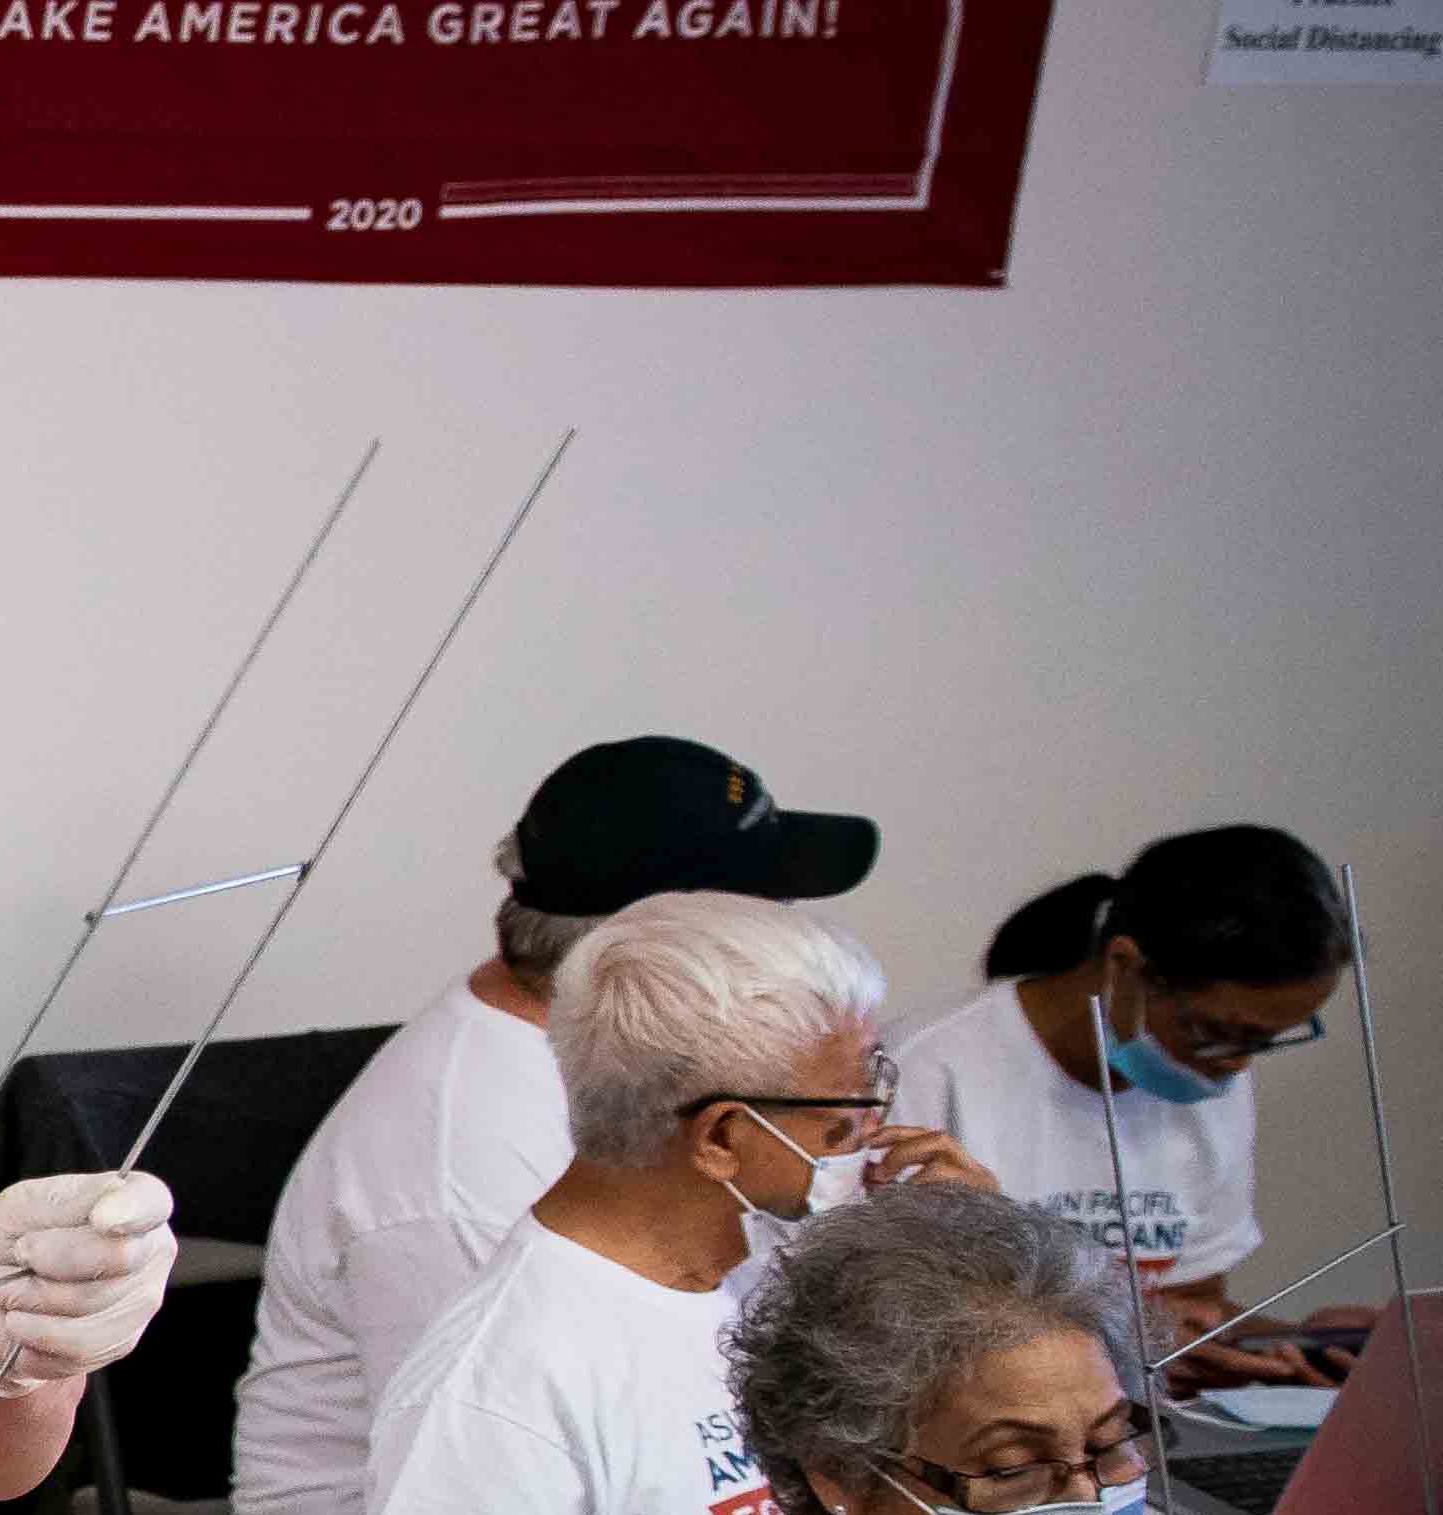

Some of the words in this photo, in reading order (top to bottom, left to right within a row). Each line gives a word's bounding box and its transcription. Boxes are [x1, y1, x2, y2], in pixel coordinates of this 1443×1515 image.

[134, 1, 405, 44] AMERICA
[427, 0, 620, 44] GREAT
[633, 0, 840, 39] AGAIN!
[326, 197, 423, 231] 2020
